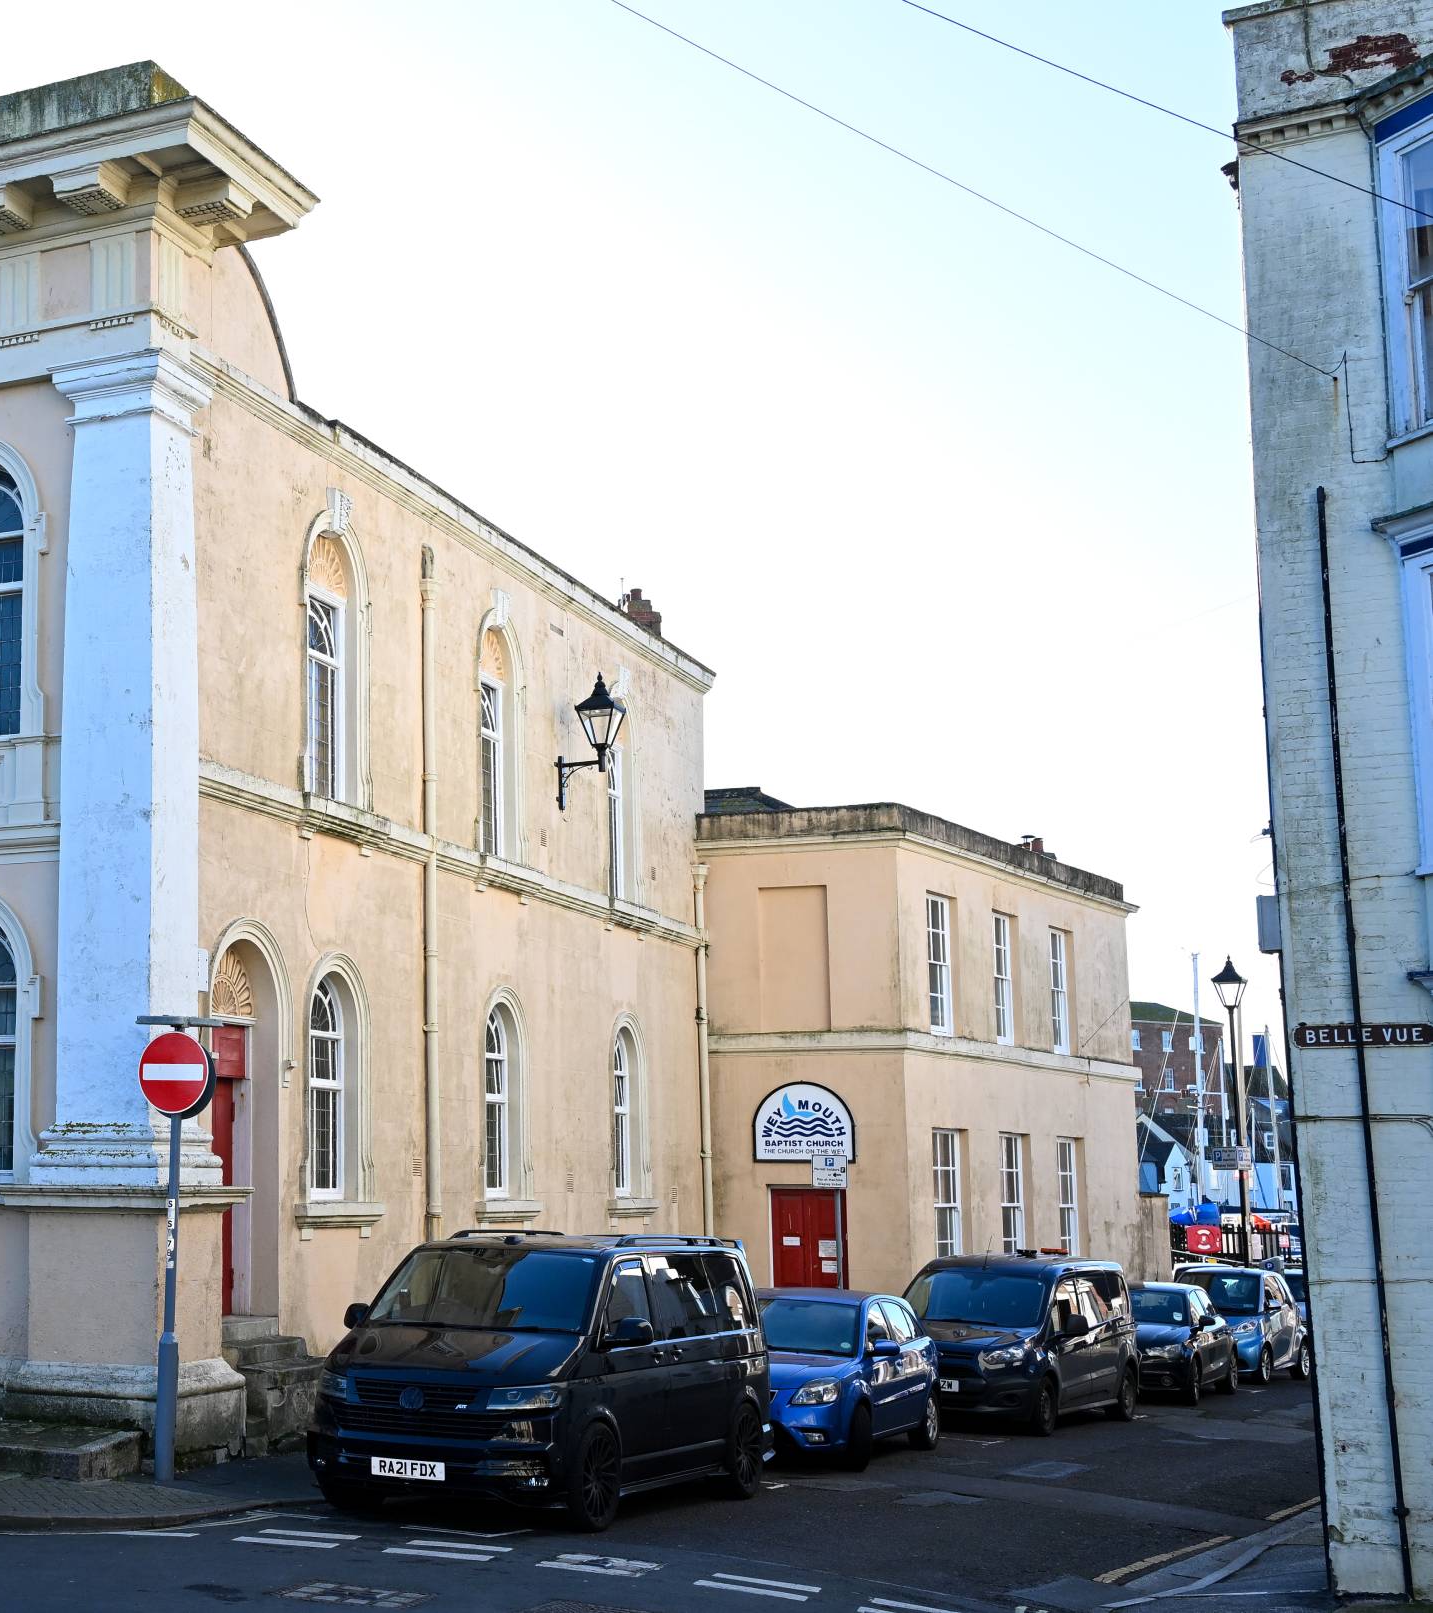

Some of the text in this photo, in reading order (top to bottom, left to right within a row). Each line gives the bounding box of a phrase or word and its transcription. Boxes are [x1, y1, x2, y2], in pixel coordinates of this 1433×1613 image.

[1306, 1027, 1424, 1043] BELLE VUE
[379, 1460, 436, 1478] RA21 FDX
